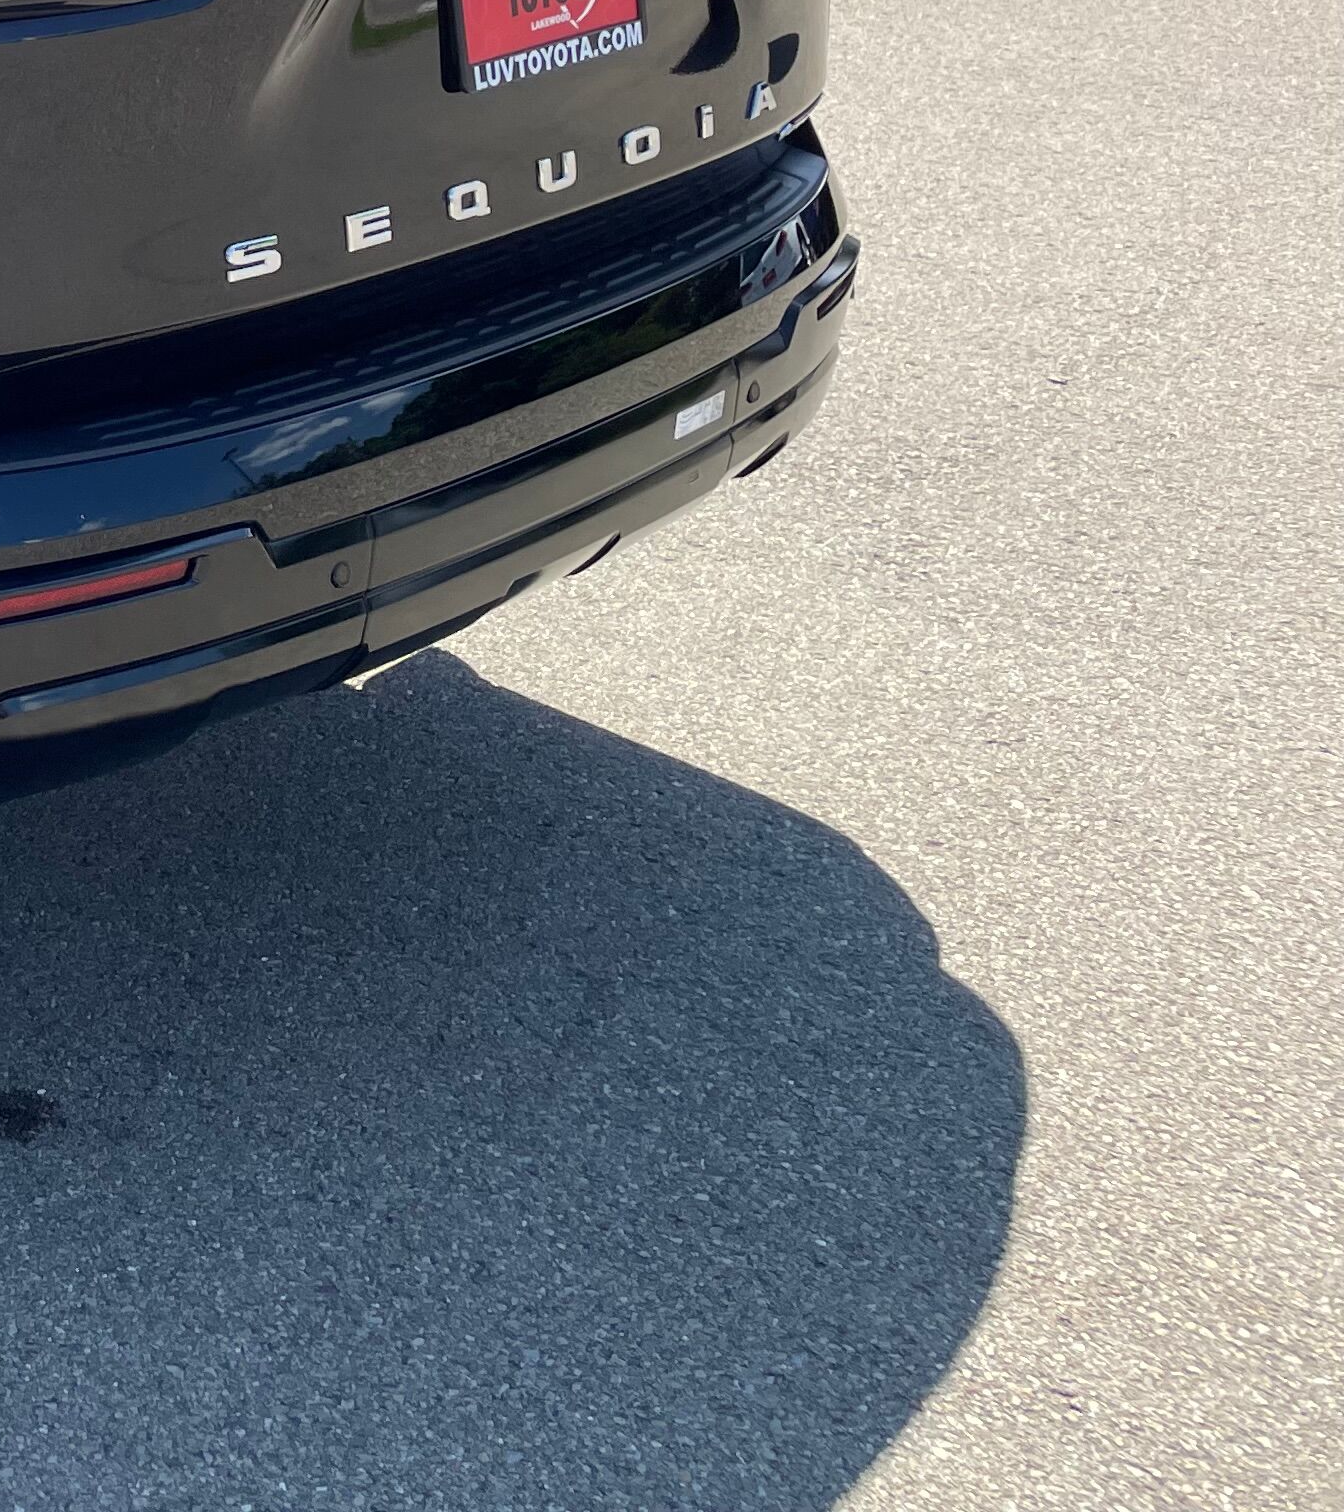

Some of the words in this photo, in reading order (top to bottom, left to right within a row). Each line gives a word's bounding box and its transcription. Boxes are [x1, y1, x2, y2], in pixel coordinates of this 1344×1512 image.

[473, 21, 644, 92] LUVTOYOTA.COM
[530, 12, 571, 31] LAKEWOOD
[225, 81, 777, 283] SEQUOIA
